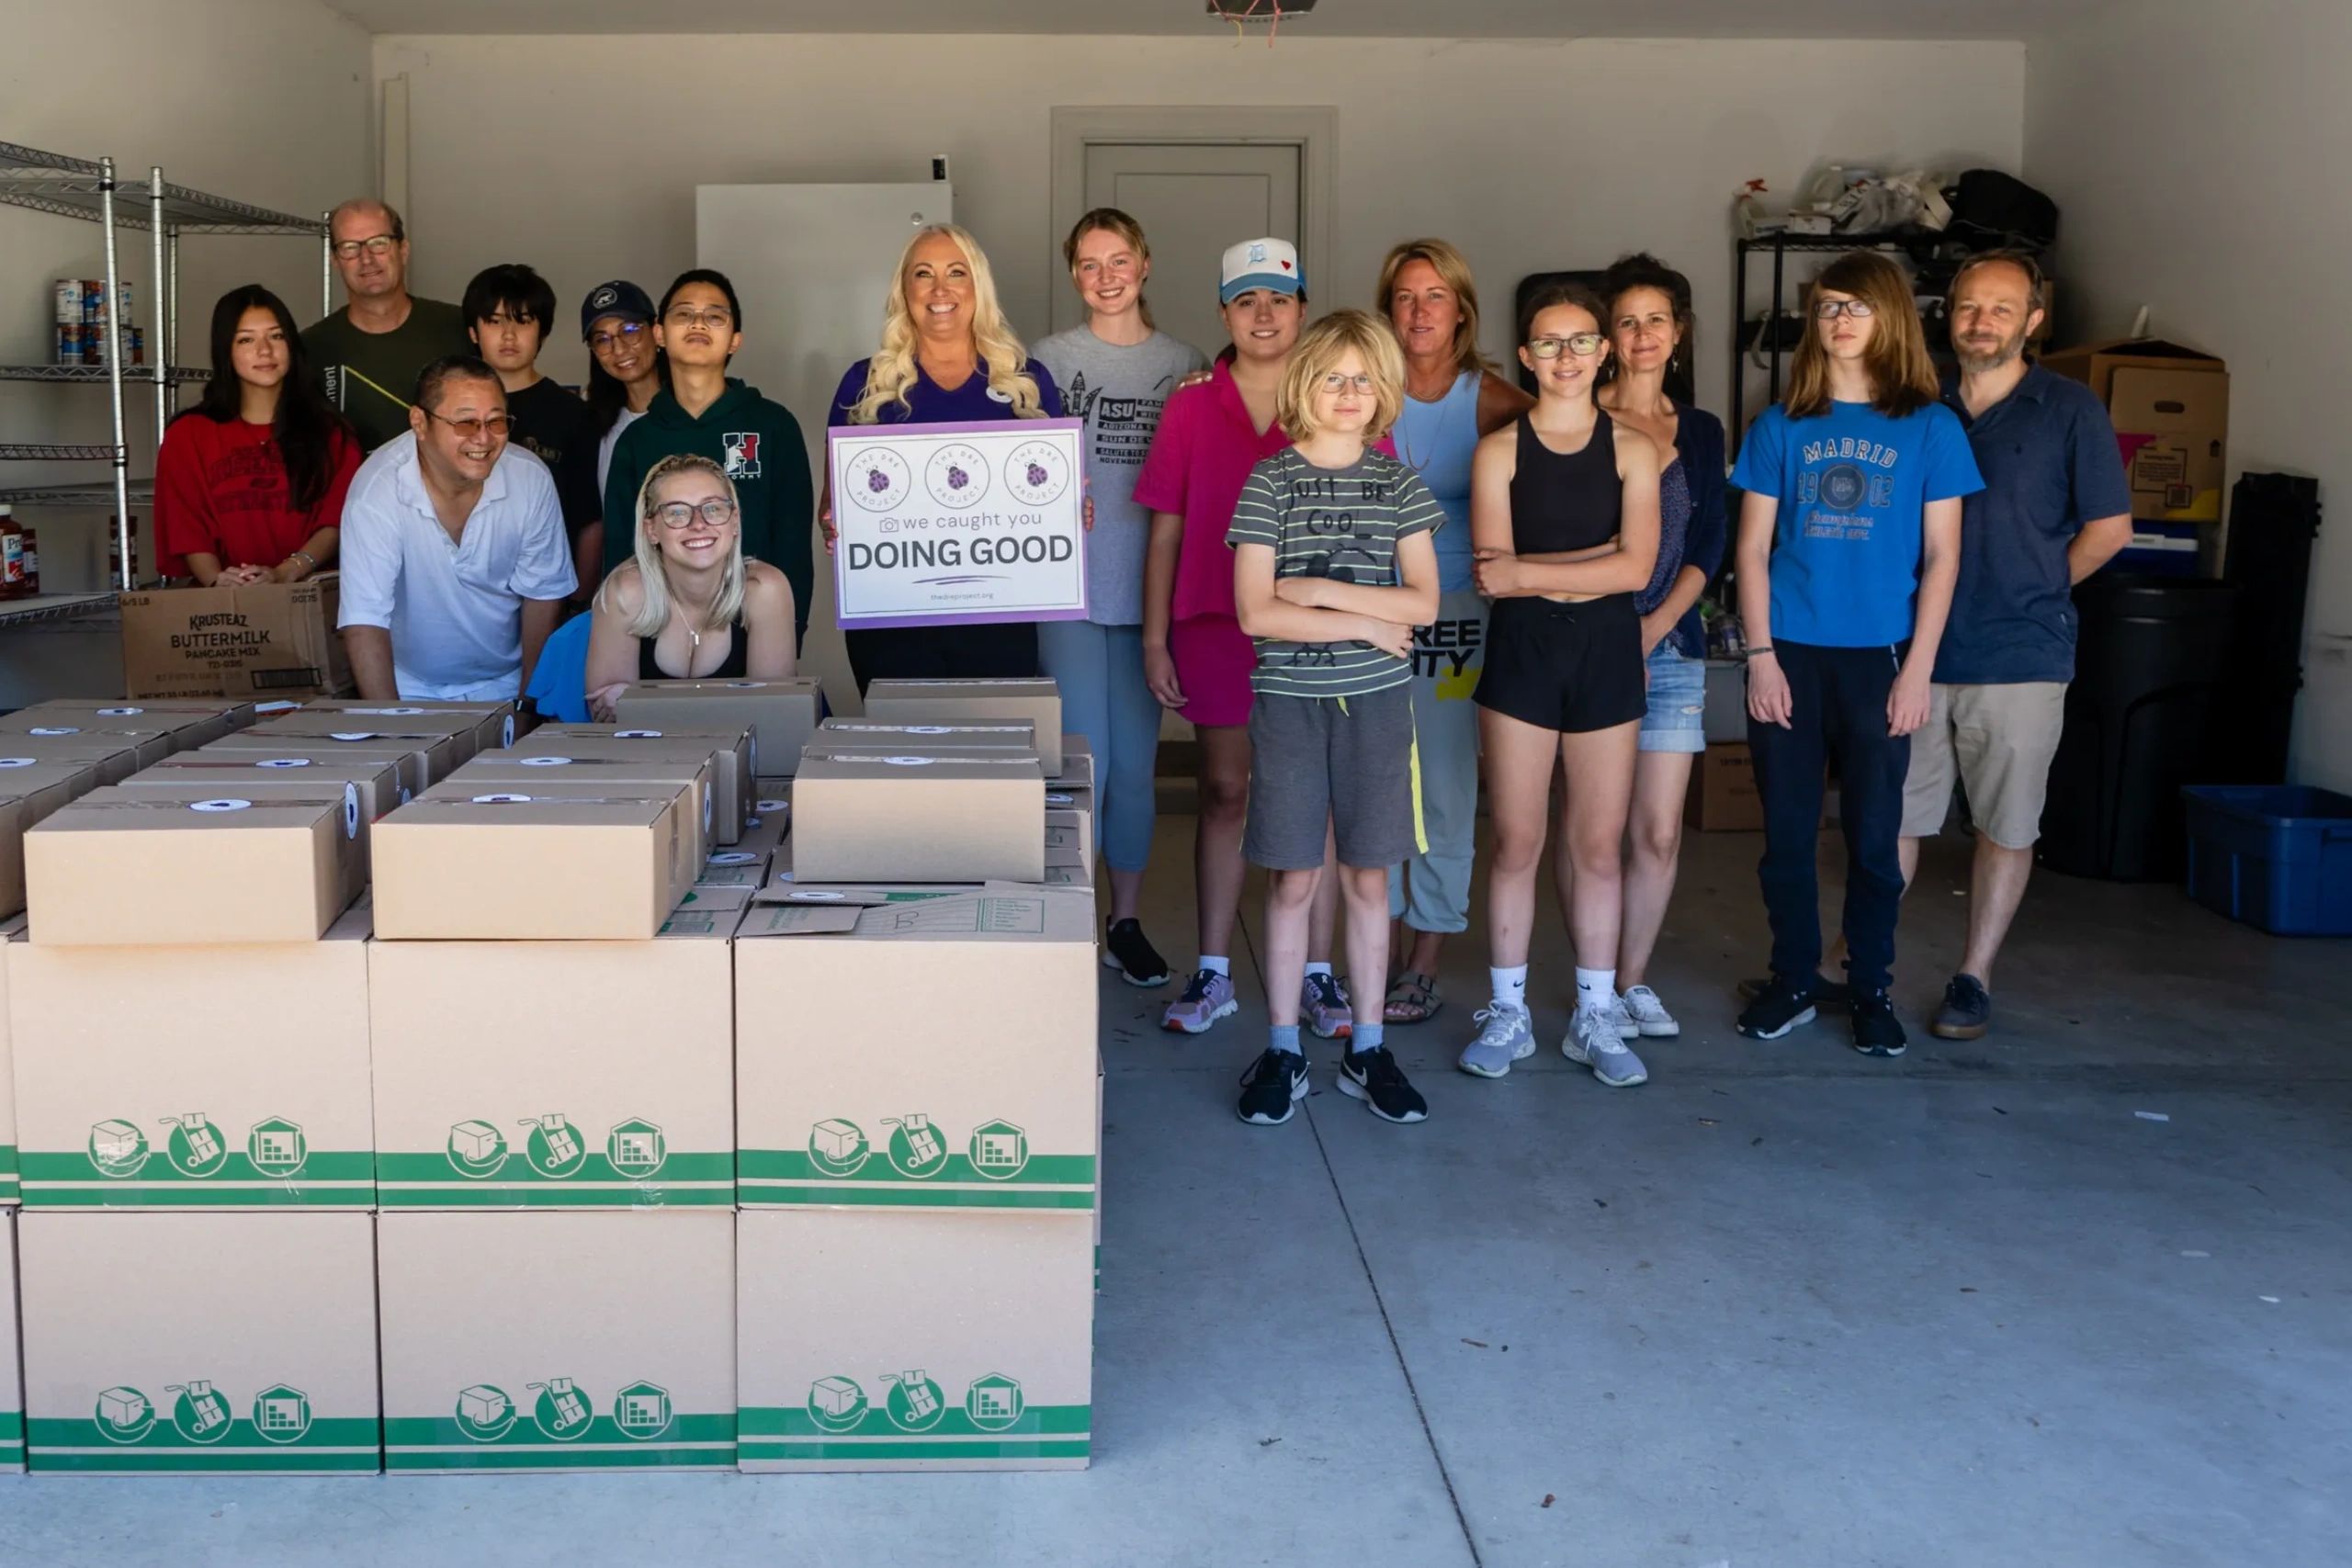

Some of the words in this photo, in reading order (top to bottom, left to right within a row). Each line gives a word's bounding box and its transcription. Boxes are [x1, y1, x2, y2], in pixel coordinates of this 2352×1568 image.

[1101, 401, 1134, 418] ASU
[722, 432, 762, 475] H
[855, 454, 874, 470] THE
[881, 454, 900, 469] DRE
[934, 451, 954, 467] THE
[960, 450, 979, 466] DRE
[1013, 447, 1033, 464] THE
[1039, 446, 1058, 462] DRE
[1804, 437, 1898, 468] MADRID
[855, 488, 901, 507] PROJECT
[935, 484, 980, 503] PROJECT
[1013, 481, 1059, 501] PROJECT
[1288, 474, 1338, 511] JUST
[1361, 481, 1390, 503] BE
[903, 516, 929, 530] we
[936, 511, 1001, 531] caught
[1009, 513, 1042, 530] you
[1307, 509, 1372, 540] COOL
[849, 539, 962, 570] DOING
[969, 535, 1073, 566] GOOD
[931, 591, 994, 602] thedreproject.org
[189, 613, 249, 631] KRUSTEAZ
[171, 630, 271, 649] BUTTERMILK
[186, 648, 237, 660] PANCAKE
[239, 647, 261, 658] MIX
[1410, 648, 1476, 678] ITY
